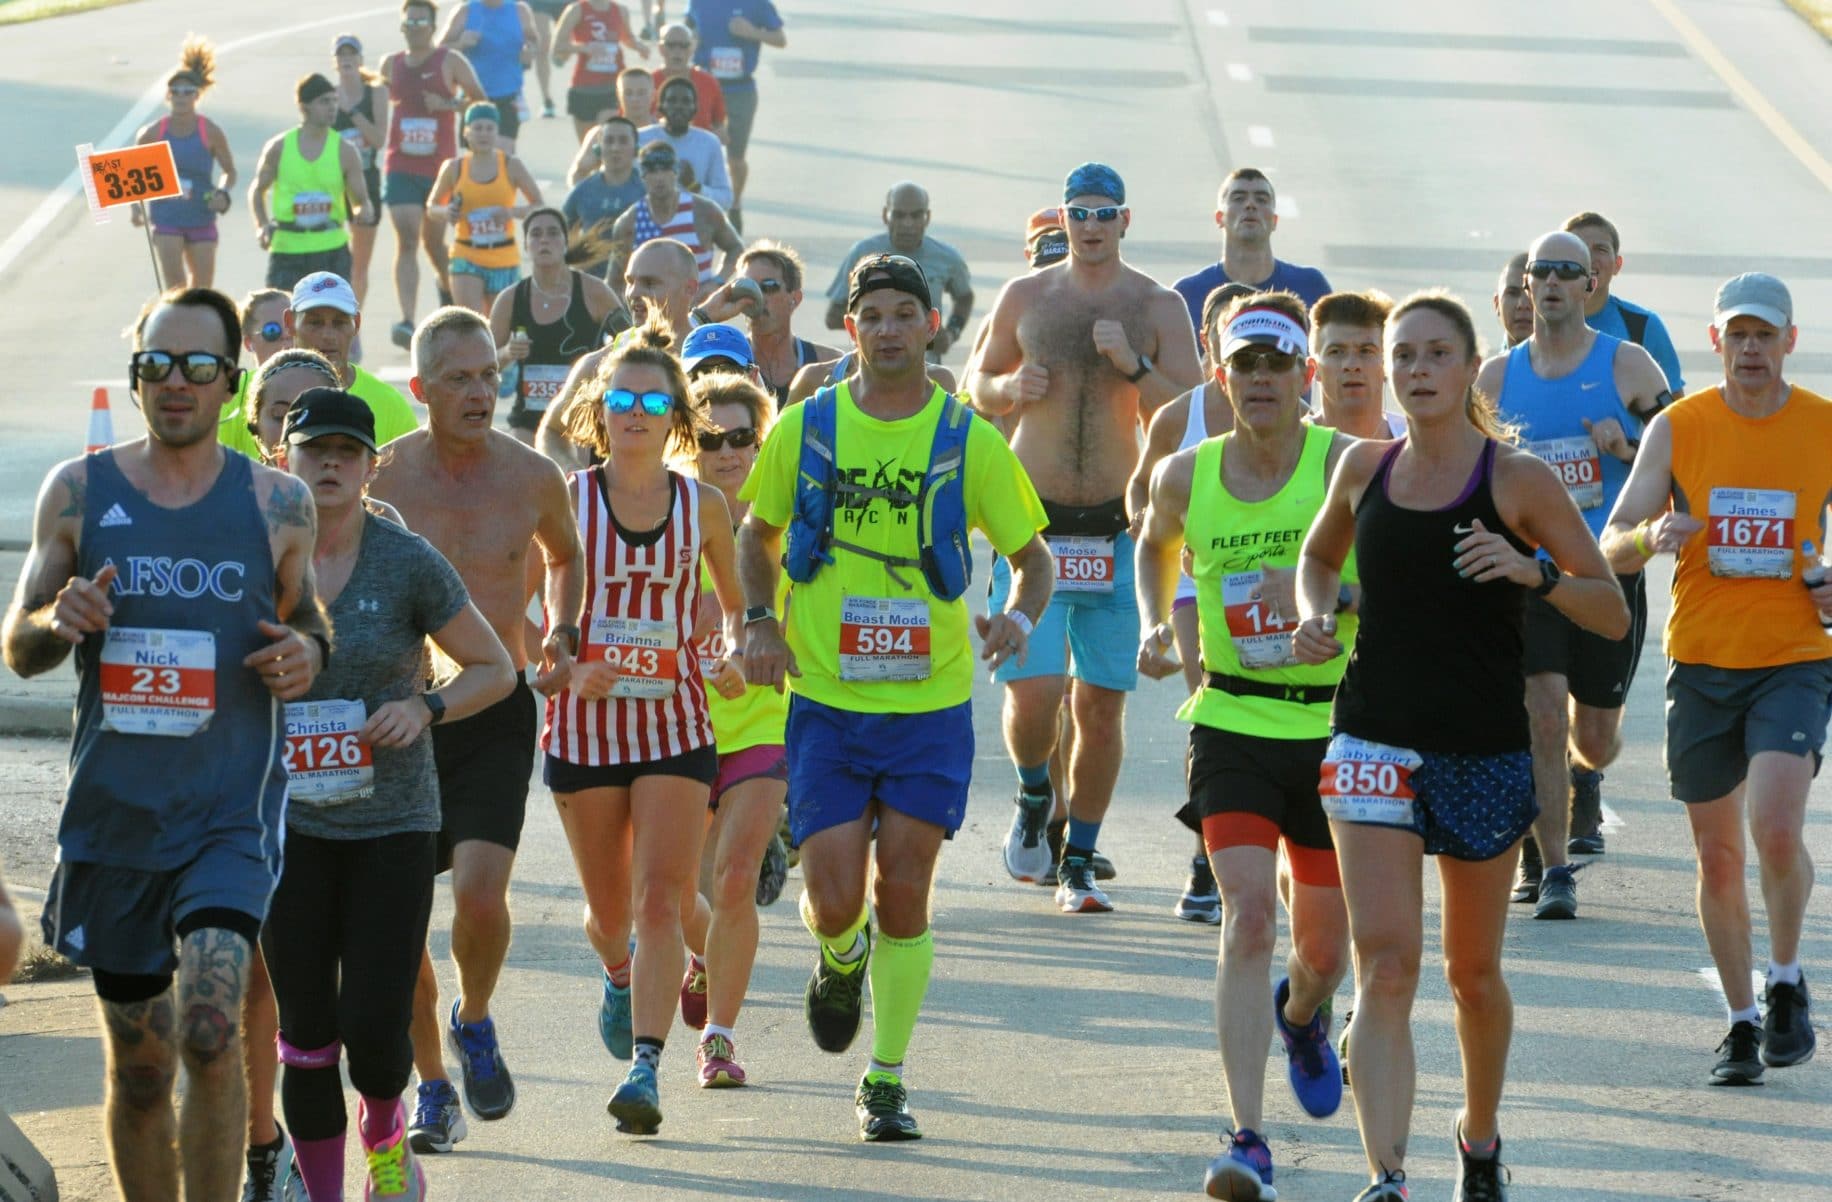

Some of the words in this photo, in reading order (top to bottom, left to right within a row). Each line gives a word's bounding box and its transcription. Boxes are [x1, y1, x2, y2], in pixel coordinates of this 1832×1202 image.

[104, 165, 165, 200] 3:35
[527, 381, 565, 397] 235
[1541, 449, 1591, 462] ILHELM
[1728, 504, 1777, 516] James
[1211, 533, 1261, 550] FLEET
[1264, 529, 1302, 544] FEET
[1716, 518, 1785, 547] 1671
[1058, 546, 1097, 556] Moose
[844, 611, 884, 625] Beast
[889, 614, 927, 625] Mode
[605, 632, 662, 647] Brianna
[856, 627, 913, 654] 594
[1265, 633, 1291, 641] MARA
[135, 650, 179, 665] Nick
[604, 645, 659, 676] 943
[131, 667, 181, 695] 23
[617, 676, 664, 686] MARATHON
[102, 691, 146, 703] MAJCOM
[148, 695, 209, 707] CHALLENGE
[110, 706, 136, 714] FULL
[140, 707, 199, 718] MARATHON
[286, 721, 347, 735] Christa
[281, 735, 362, 770] 2126
[1379, 752, 1411, 766] Girl
[288, 773, 305, 781] ULL
[308, 768, 360, 778] MARATHON
[1334, 762, 1399, 795] 850
[1351, 797, 1406, 806] MARATHON
